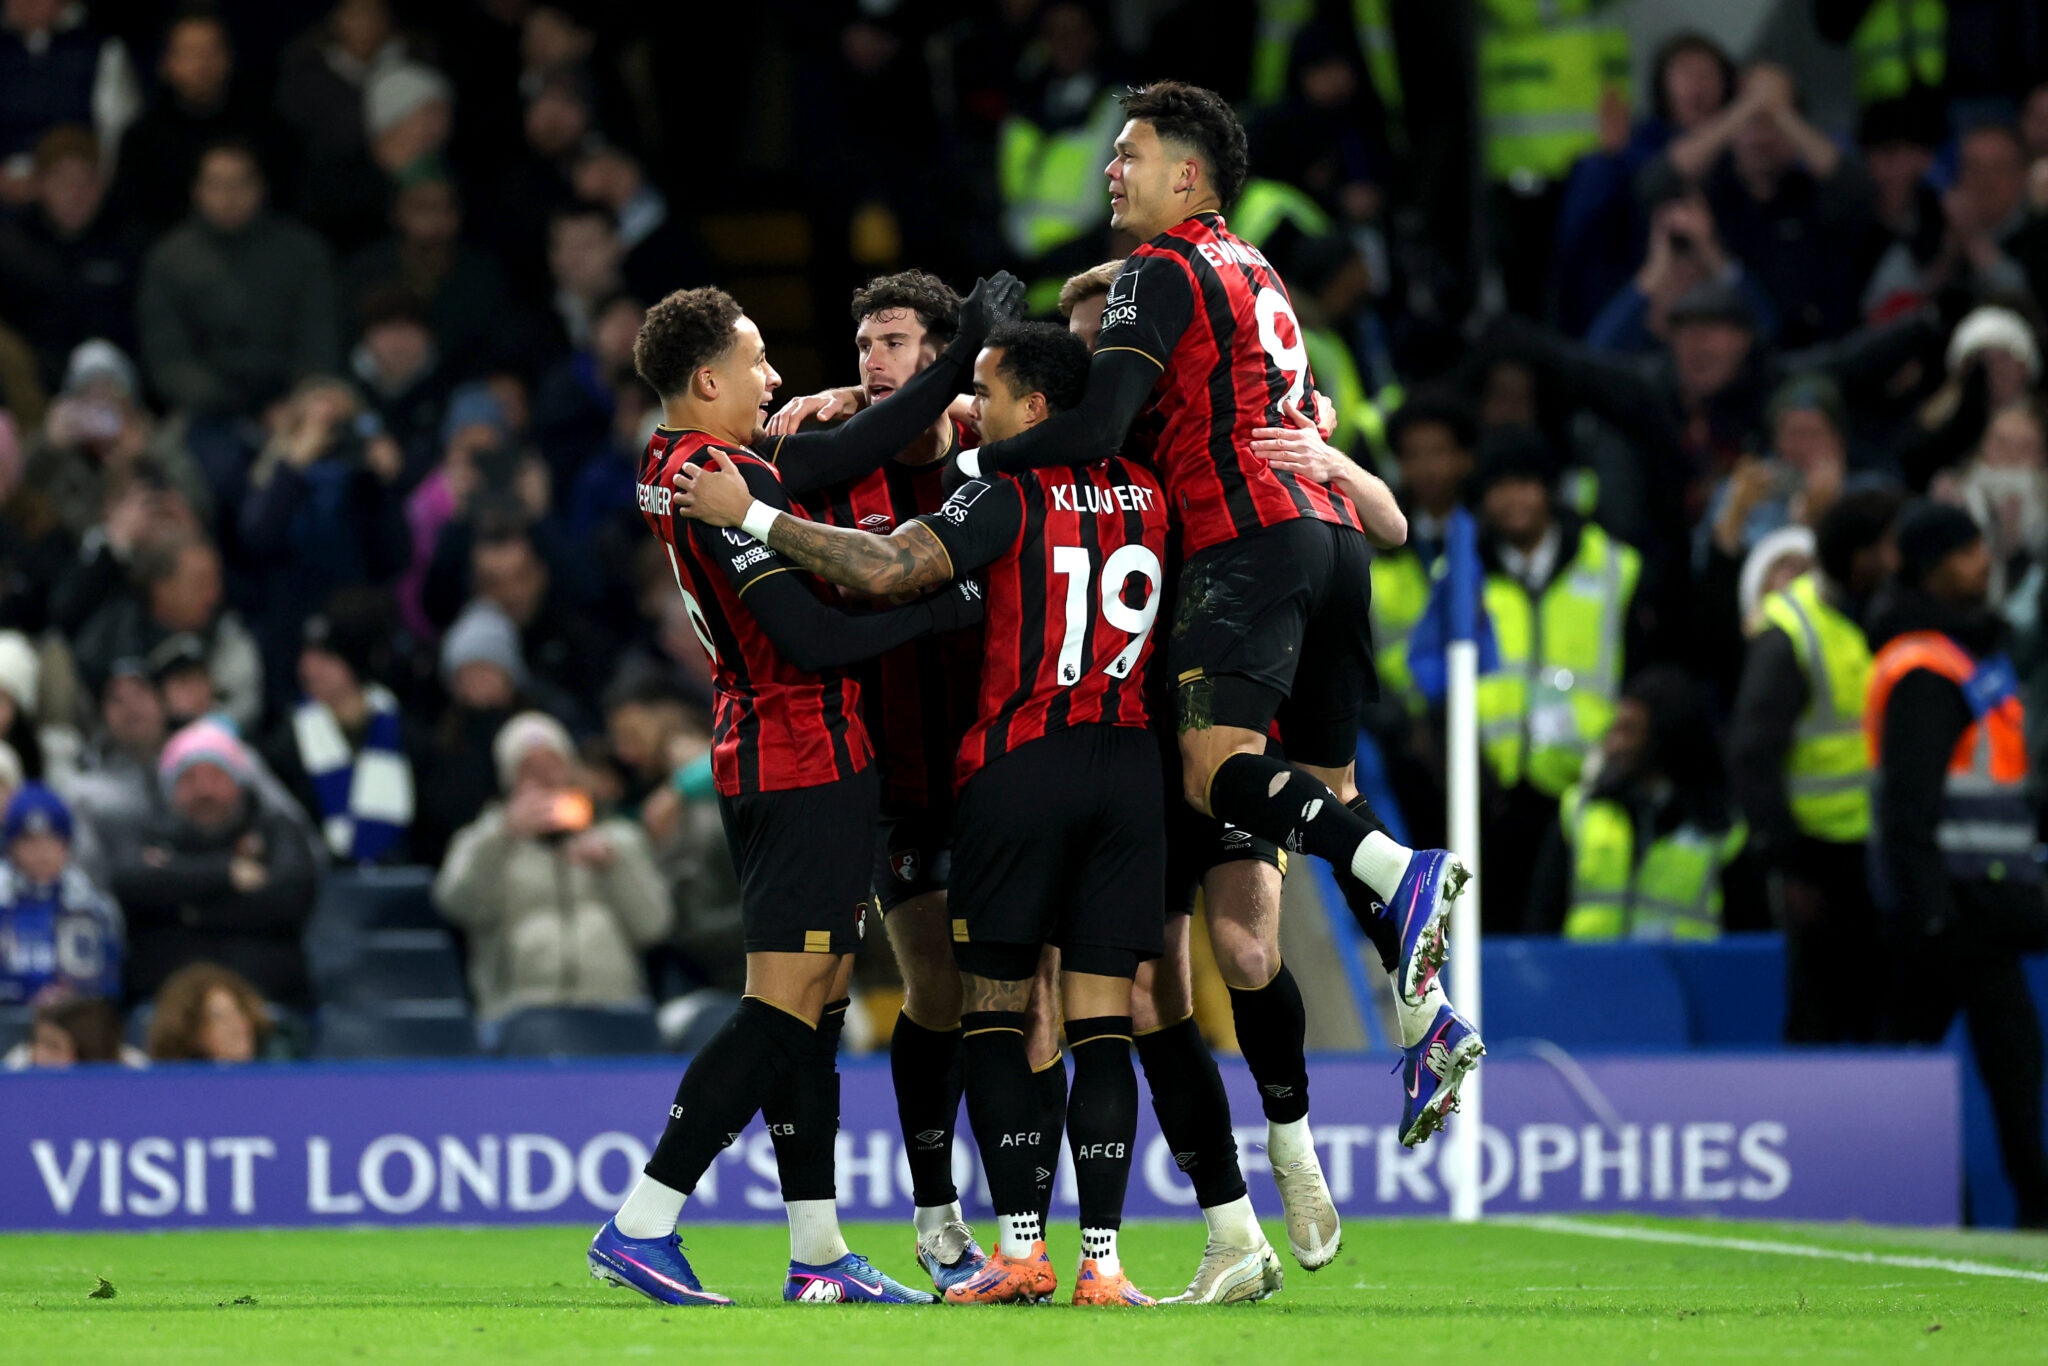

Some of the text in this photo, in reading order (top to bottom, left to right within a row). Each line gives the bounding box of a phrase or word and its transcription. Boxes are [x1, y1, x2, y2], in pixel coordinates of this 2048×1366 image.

[1255, 287, 1308, 417] 9
[745, 544, 770, 559] room
[958, 583, 971, 601] mbro
[1053, 544, 1162, 687] 19
[1000, 1132, 1041, 1147] AFCB
[1079, 1142, 1125, 1160] AFCB
[30, 1136, 275, 1216] VISIT
[1312, 1121, 1793, 1206] TROPHIES
